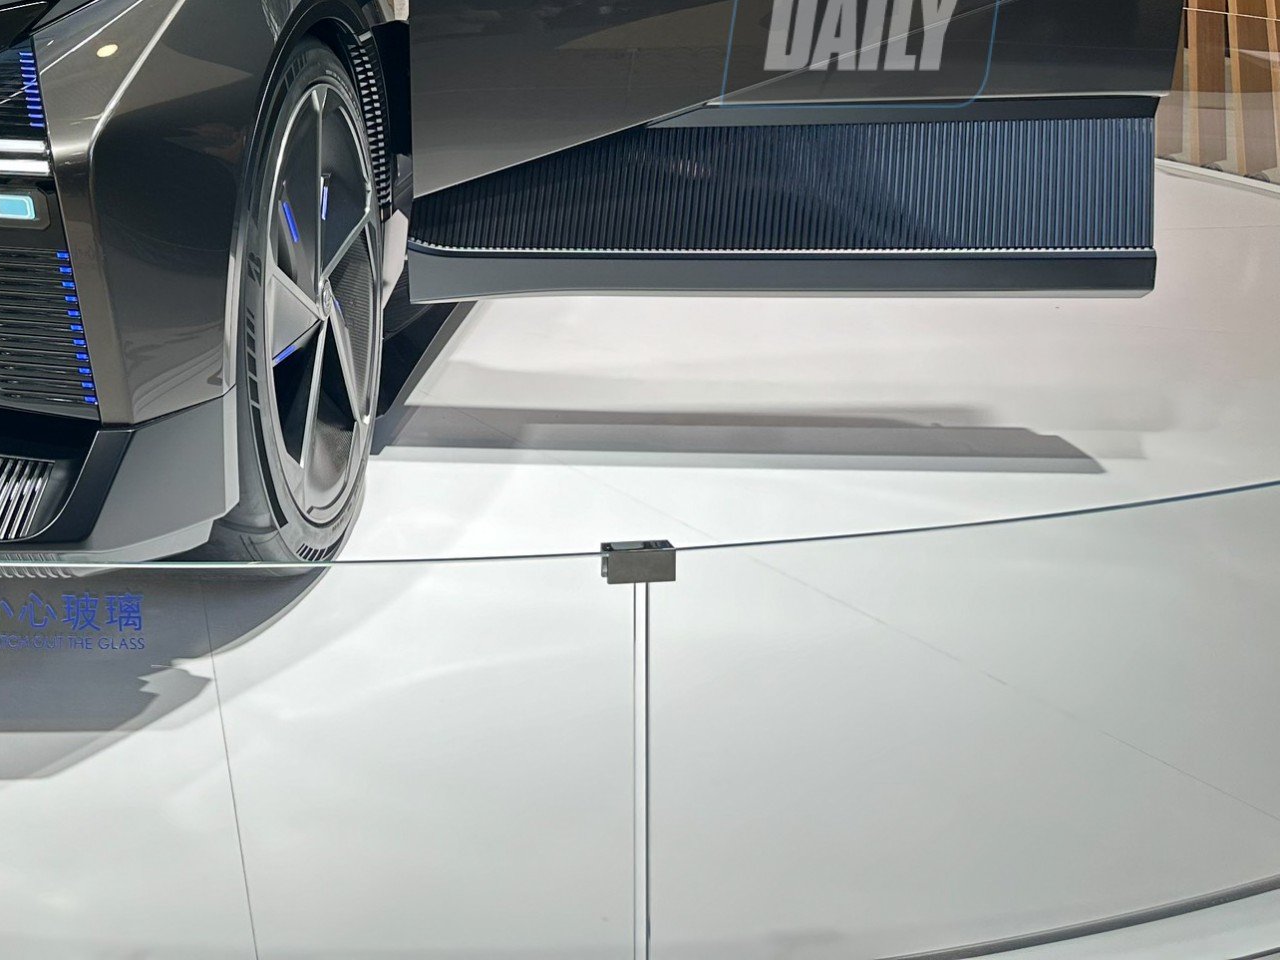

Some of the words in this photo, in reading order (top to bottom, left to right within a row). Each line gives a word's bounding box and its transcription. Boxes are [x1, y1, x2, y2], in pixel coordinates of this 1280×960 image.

[33, 635, 63, 649] OUT
[67, 637, 92, 649] THE
[98, 637, 145, 649] GLASS
